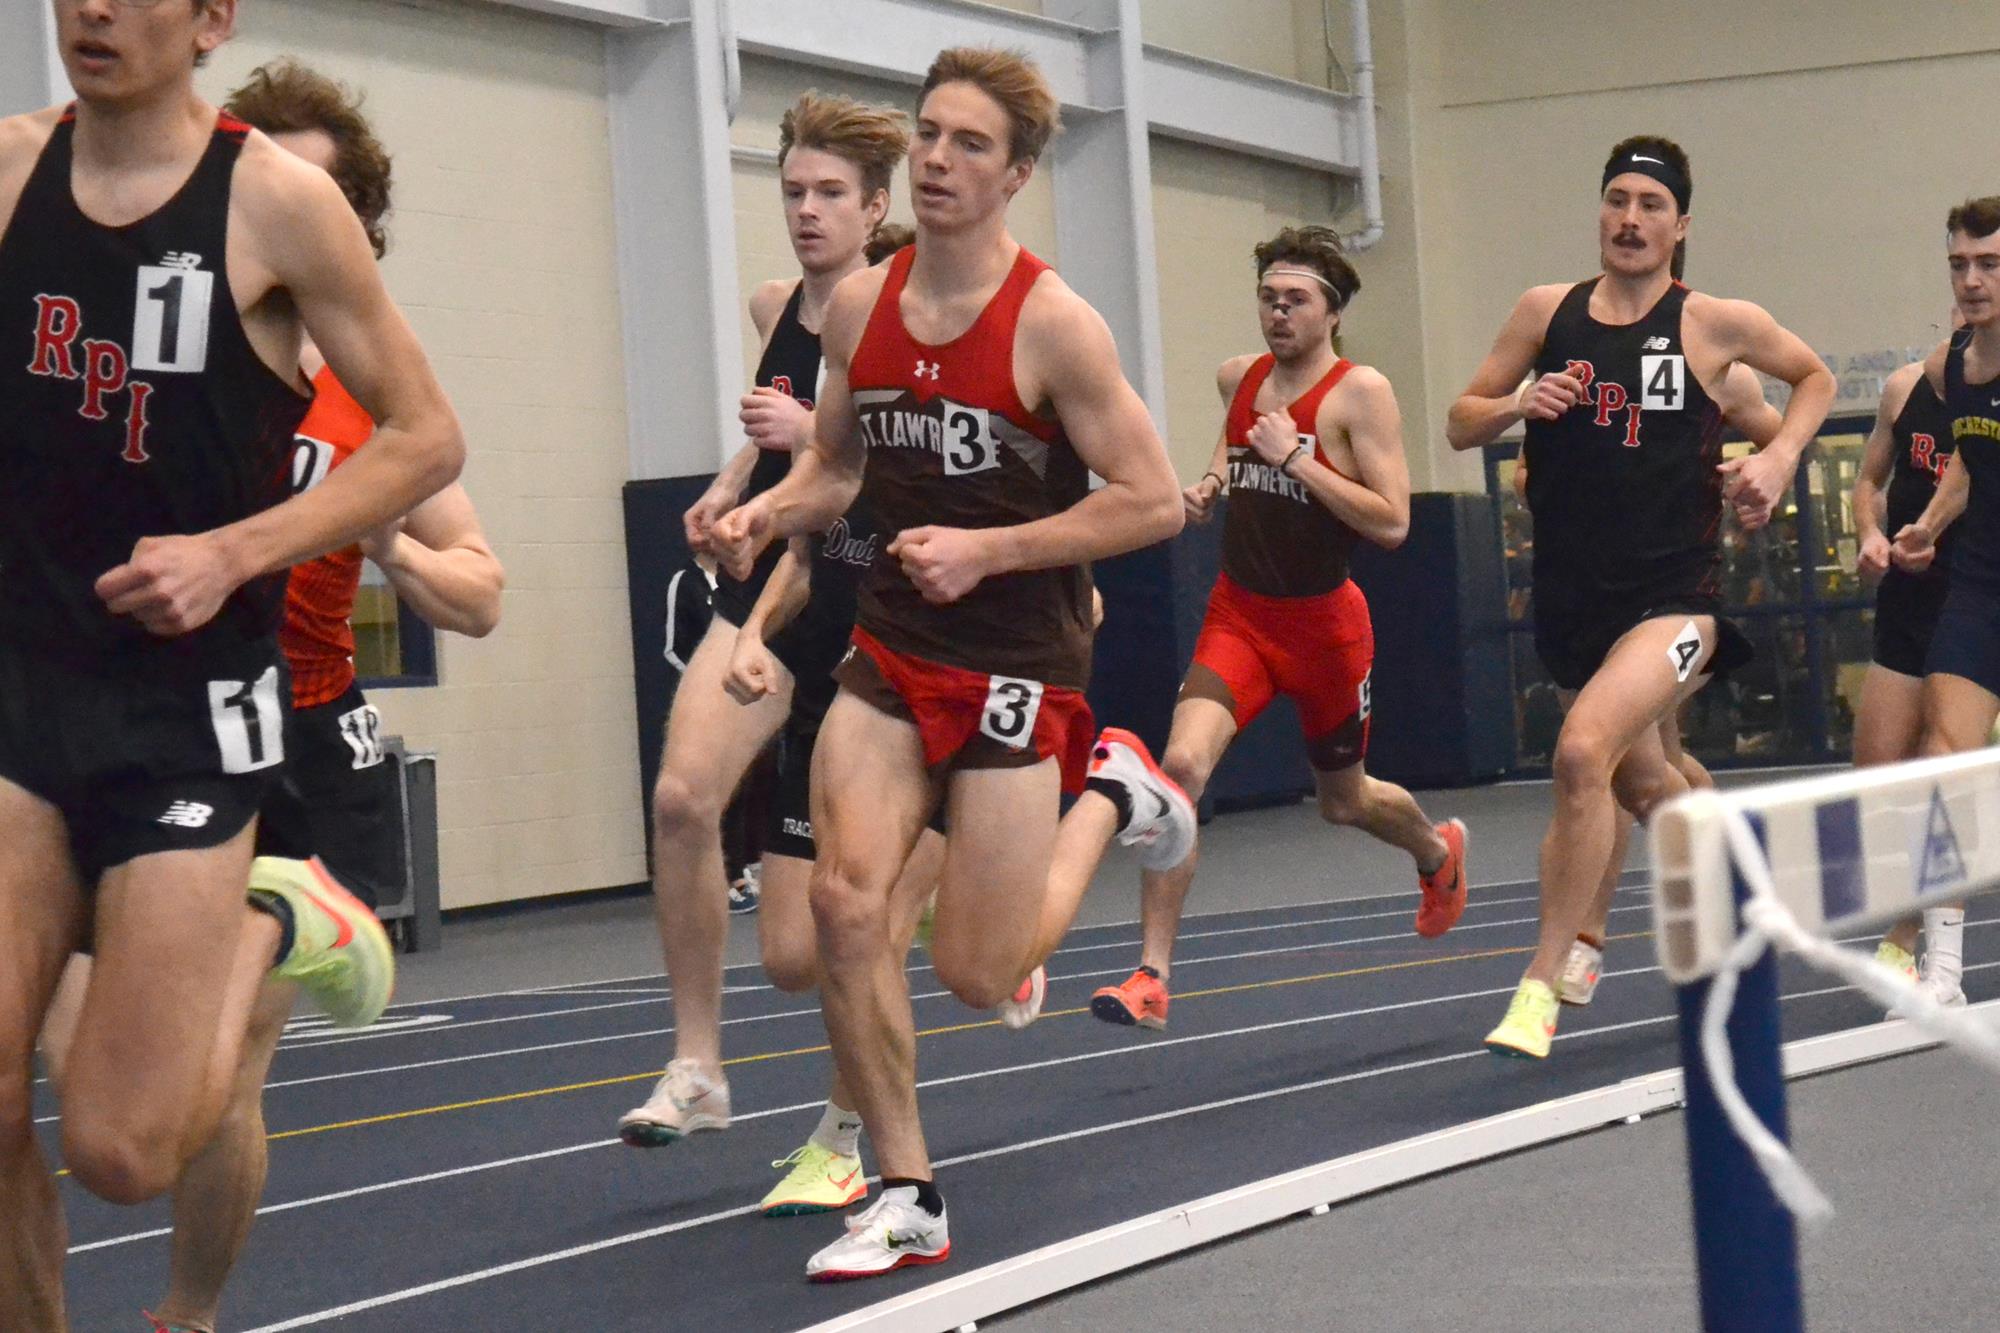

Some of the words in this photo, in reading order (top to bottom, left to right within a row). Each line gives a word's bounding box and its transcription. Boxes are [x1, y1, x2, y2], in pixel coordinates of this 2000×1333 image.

[147, 275, 184, 364] 1
[27, 293, 153, 464] RPI
[1647, 358, 1679, 407] 4
[948, 410, 986, 471] 3
[1675, 638, 1701, 675] 4
[223, 679, 265, 764] 1
[988, 682, 1032, 738] 3
[783, 817, 815, 839] TRAC
